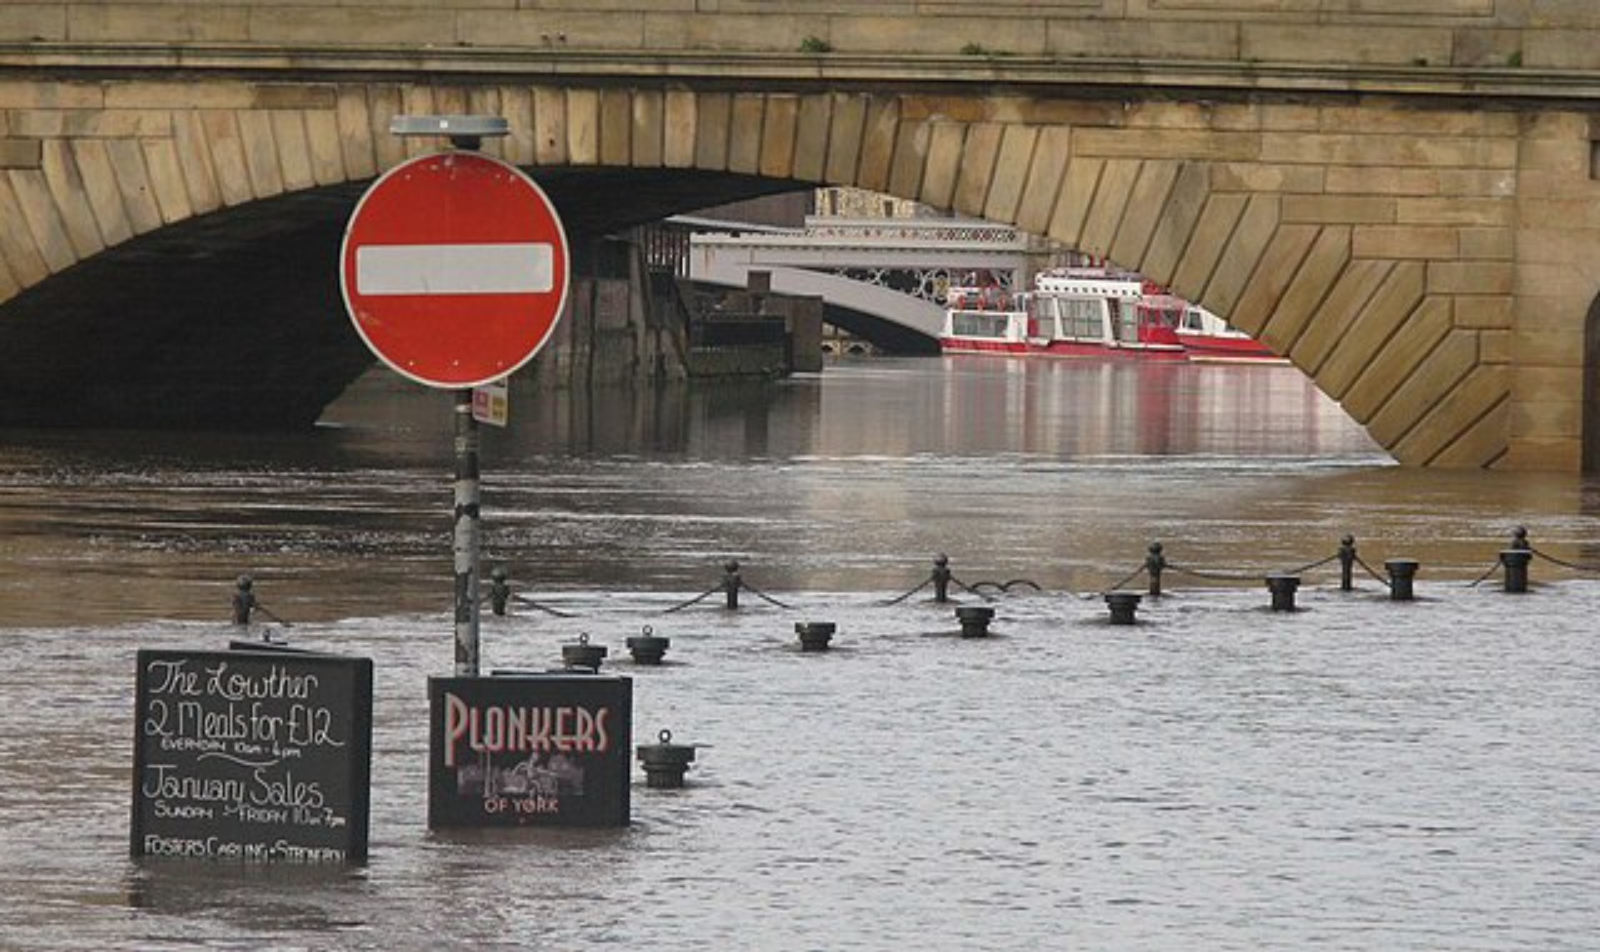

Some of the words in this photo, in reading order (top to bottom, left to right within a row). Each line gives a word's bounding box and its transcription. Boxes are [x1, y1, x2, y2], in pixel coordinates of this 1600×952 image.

[147, 659, 201, 695] The
[205, 661, 318, 700] Lowther
[144, 699, 173, 736] 2
[178, 701, 248, 738] Meals
[251, 702, 283, 740] for
[289, 704, 345, 746] £12
[444, 692, 609, 766] PLONKERS
[142, 764, 244, 802] January
[250, 767, 323, 808] Sales
[484, 800, 507, 813] OF
[514, 800, 559, 813] YORK
